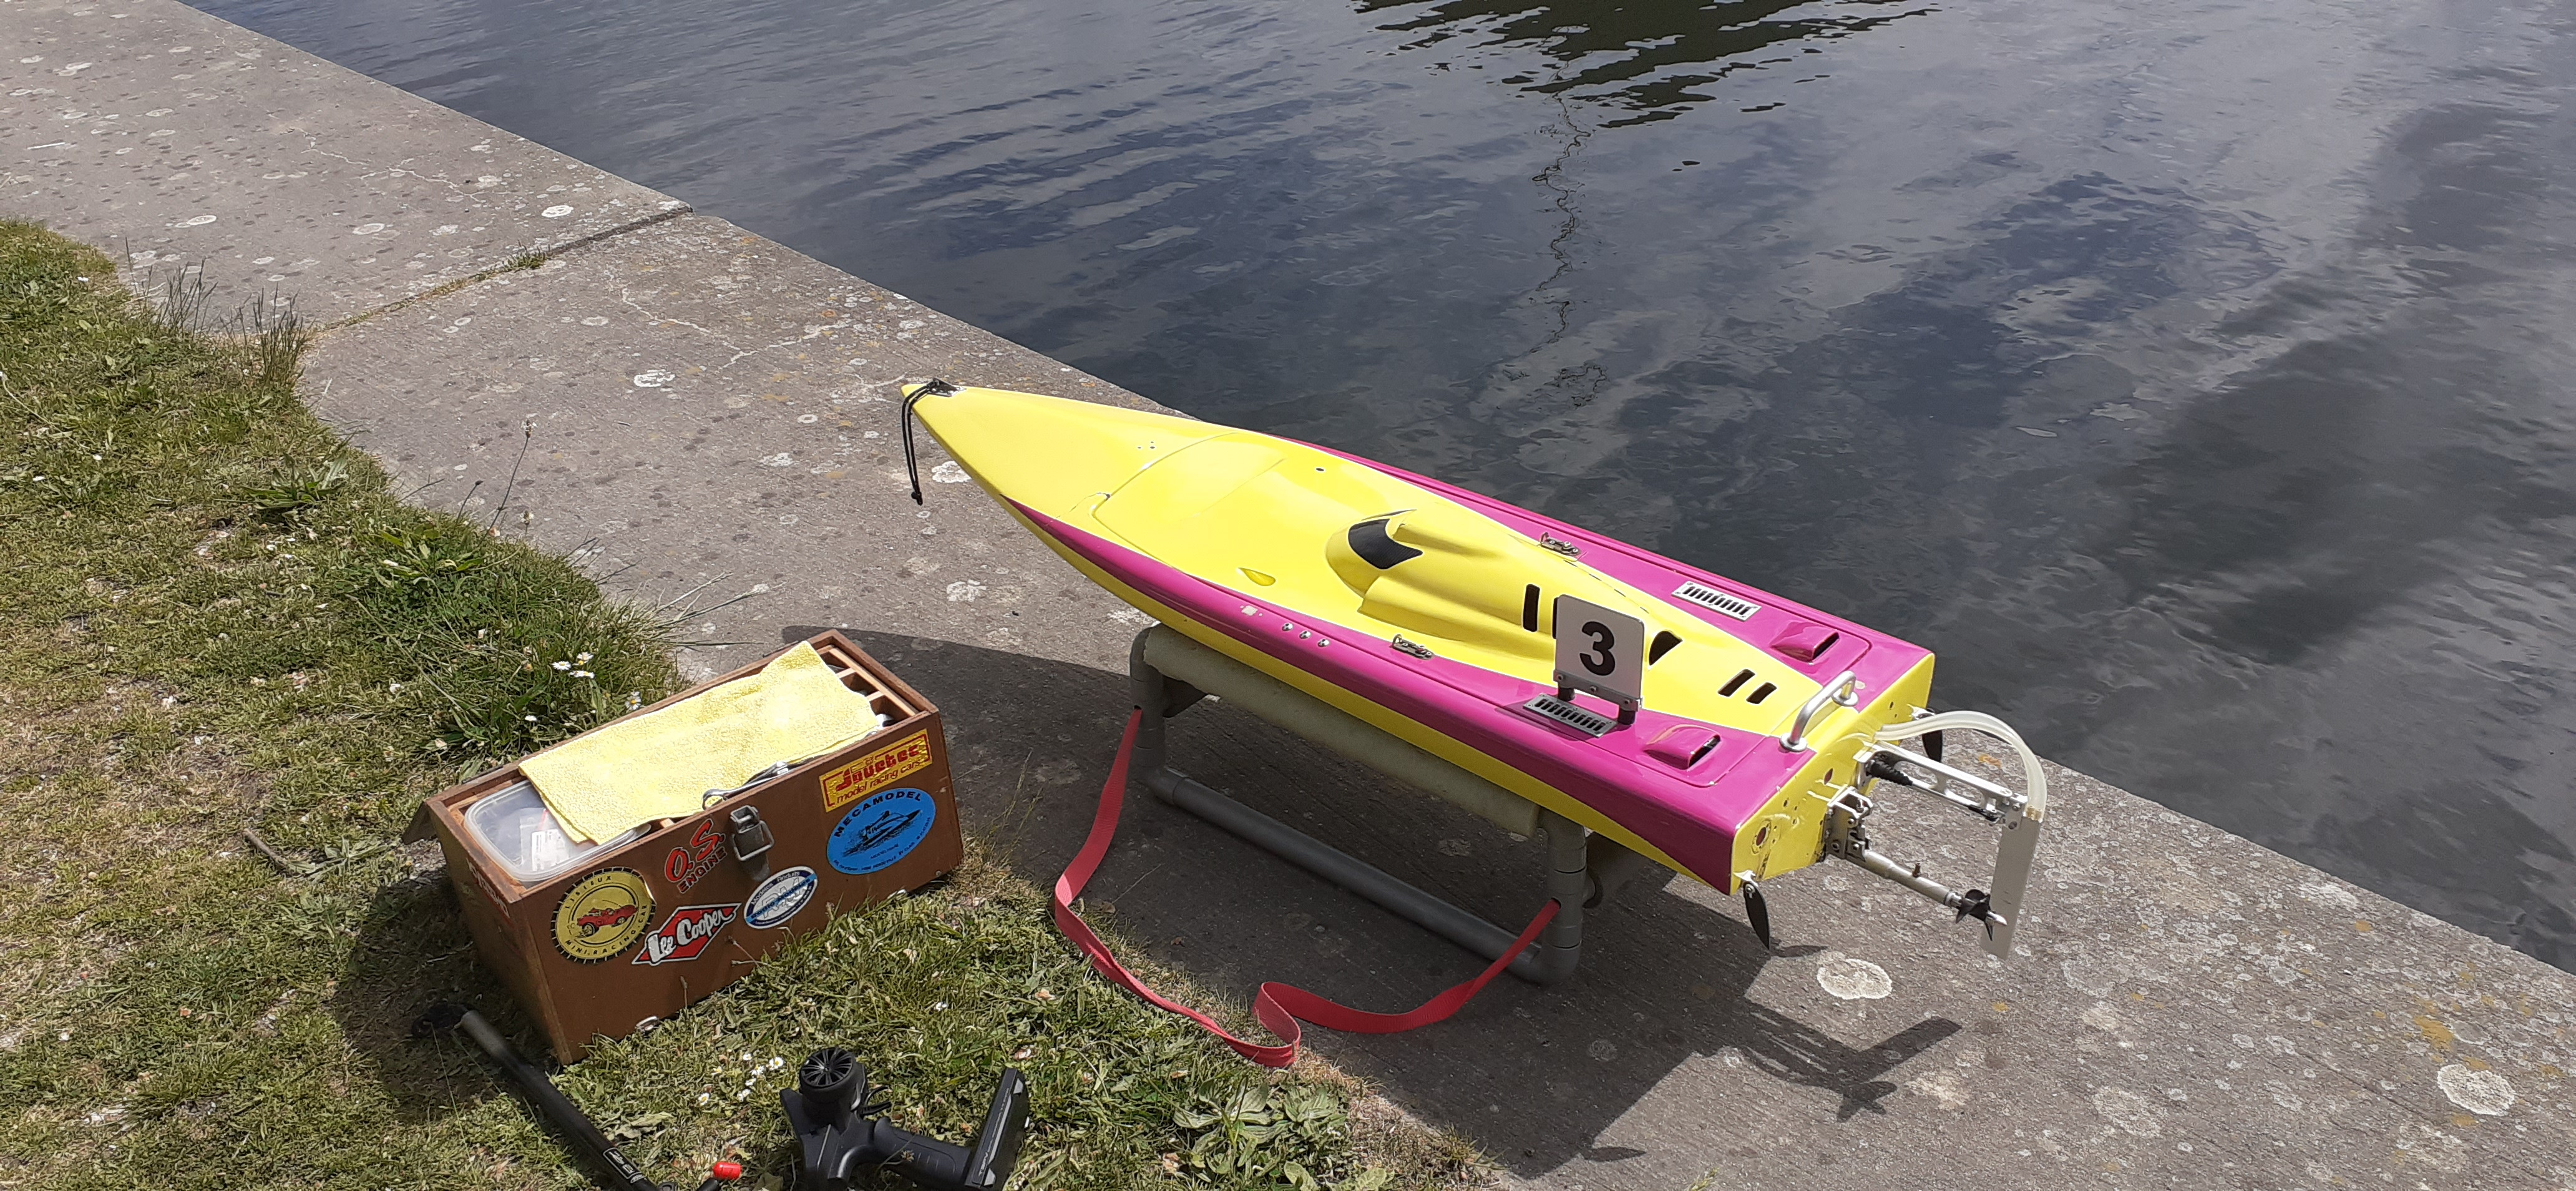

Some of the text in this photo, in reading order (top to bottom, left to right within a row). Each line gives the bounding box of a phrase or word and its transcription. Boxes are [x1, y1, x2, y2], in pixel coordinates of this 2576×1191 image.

[1579, 621, 1616, 676] 3
[837, 760, 920, 803] model racing cars
[834, 791, 921, 838] MECAMODEL
[665, 818, 725, 882] O.S.
[677, 846, 727, 893] ENGINE
[565, 875, 612, 909] LISIEUX
[648, 908, 733, 962] Lee Cooper
